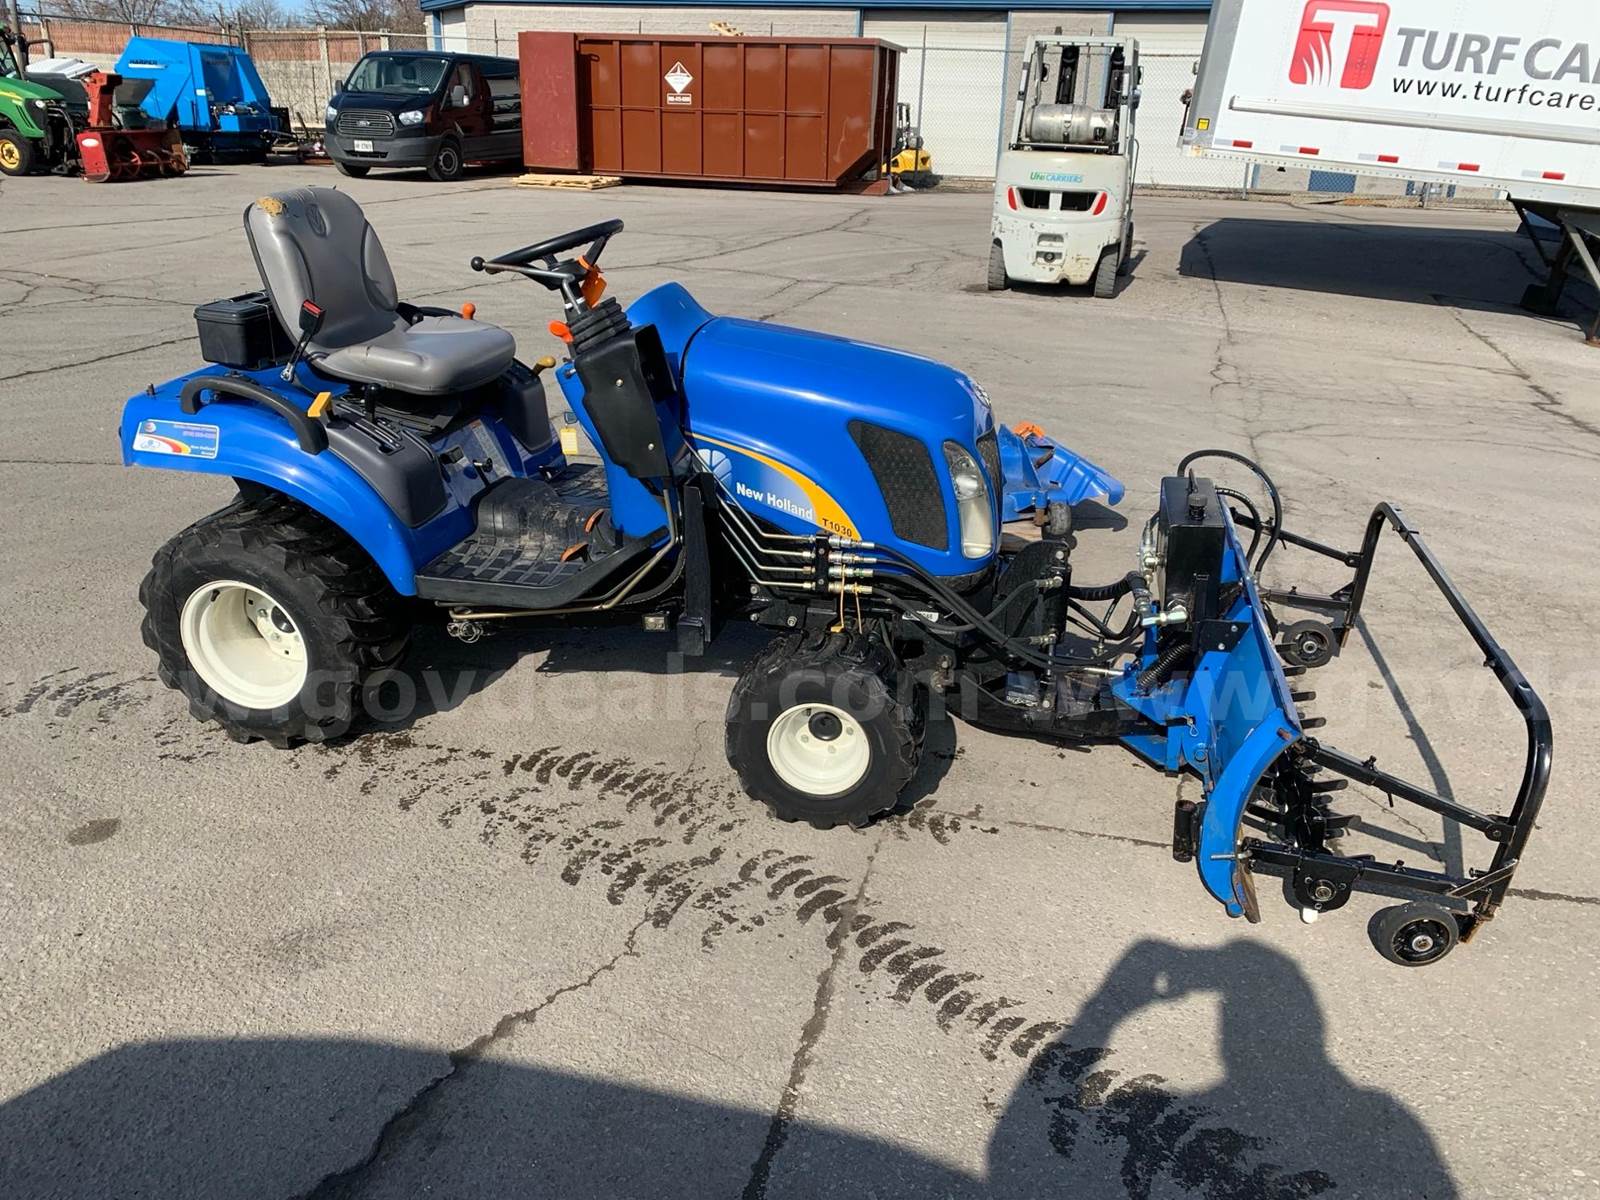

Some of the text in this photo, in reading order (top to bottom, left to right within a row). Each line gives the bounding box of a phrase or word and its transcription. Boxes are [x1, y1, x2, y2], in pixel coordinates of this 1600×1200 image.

[1397, 27, 1521, 75] TURF
[736, 482, 813, 520] New Holland
[822, 518, 852, 537] T1030
